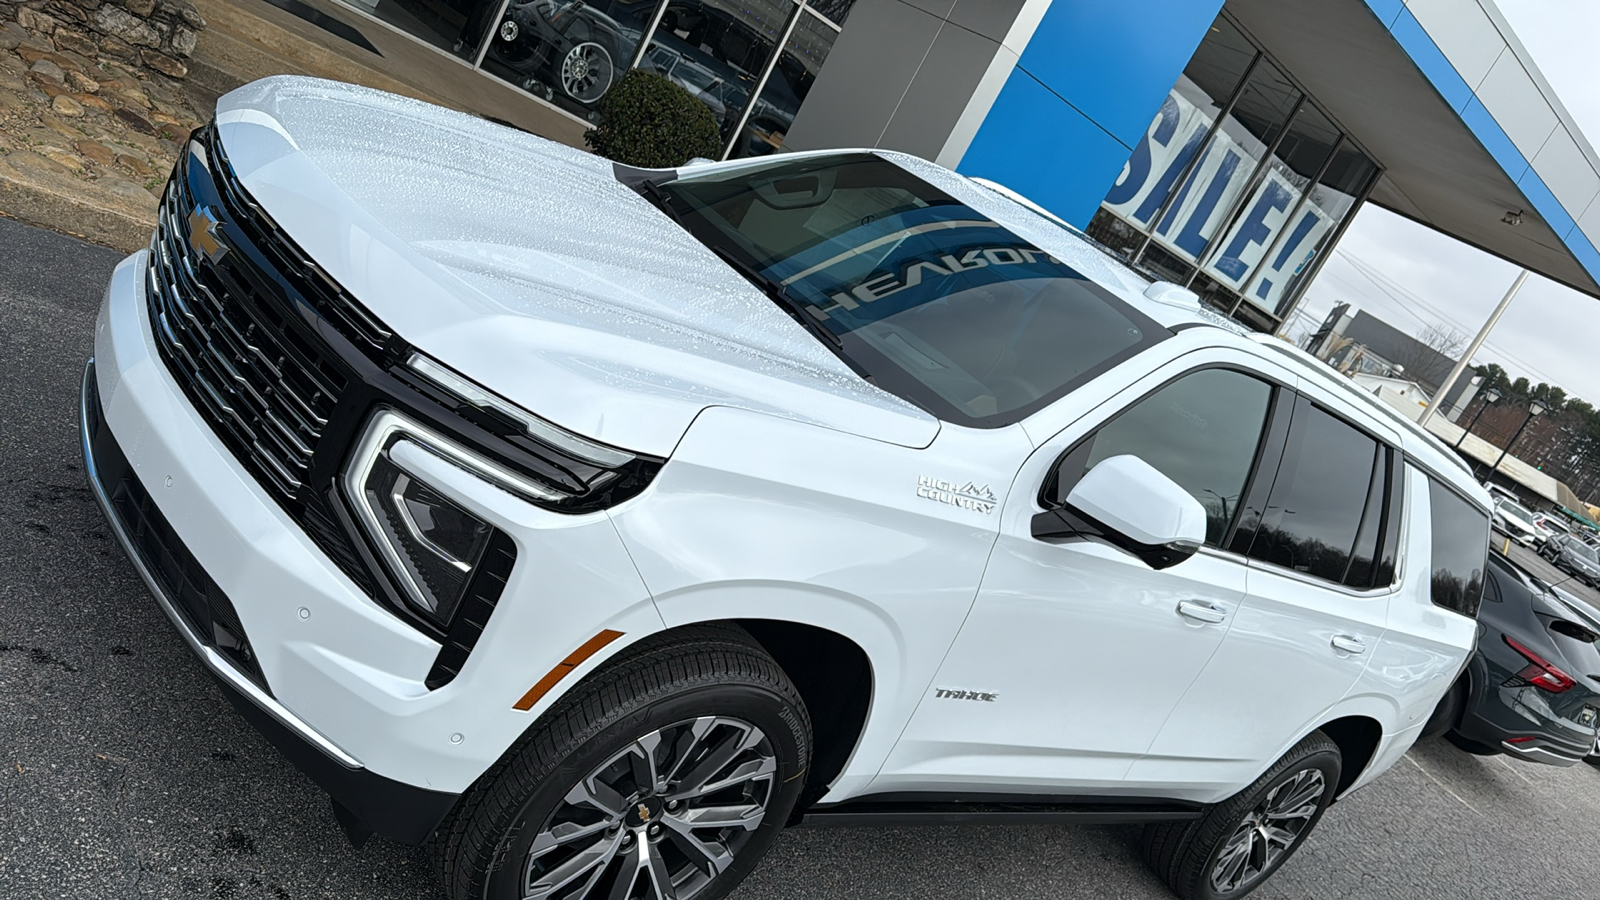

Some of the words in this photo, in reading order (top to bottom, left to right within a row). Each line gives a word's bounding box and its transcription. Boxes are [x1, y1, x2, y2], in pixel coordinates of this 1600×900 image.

[1104, 94, 1320, 300] SALE!
[918, 475, 961, 495] HIGH
[917, 486, 995, 514] COUNTRY
[936, 687, 999, 702] TAHOE
[778, 705, 806, 769] BRIDGESTONE
